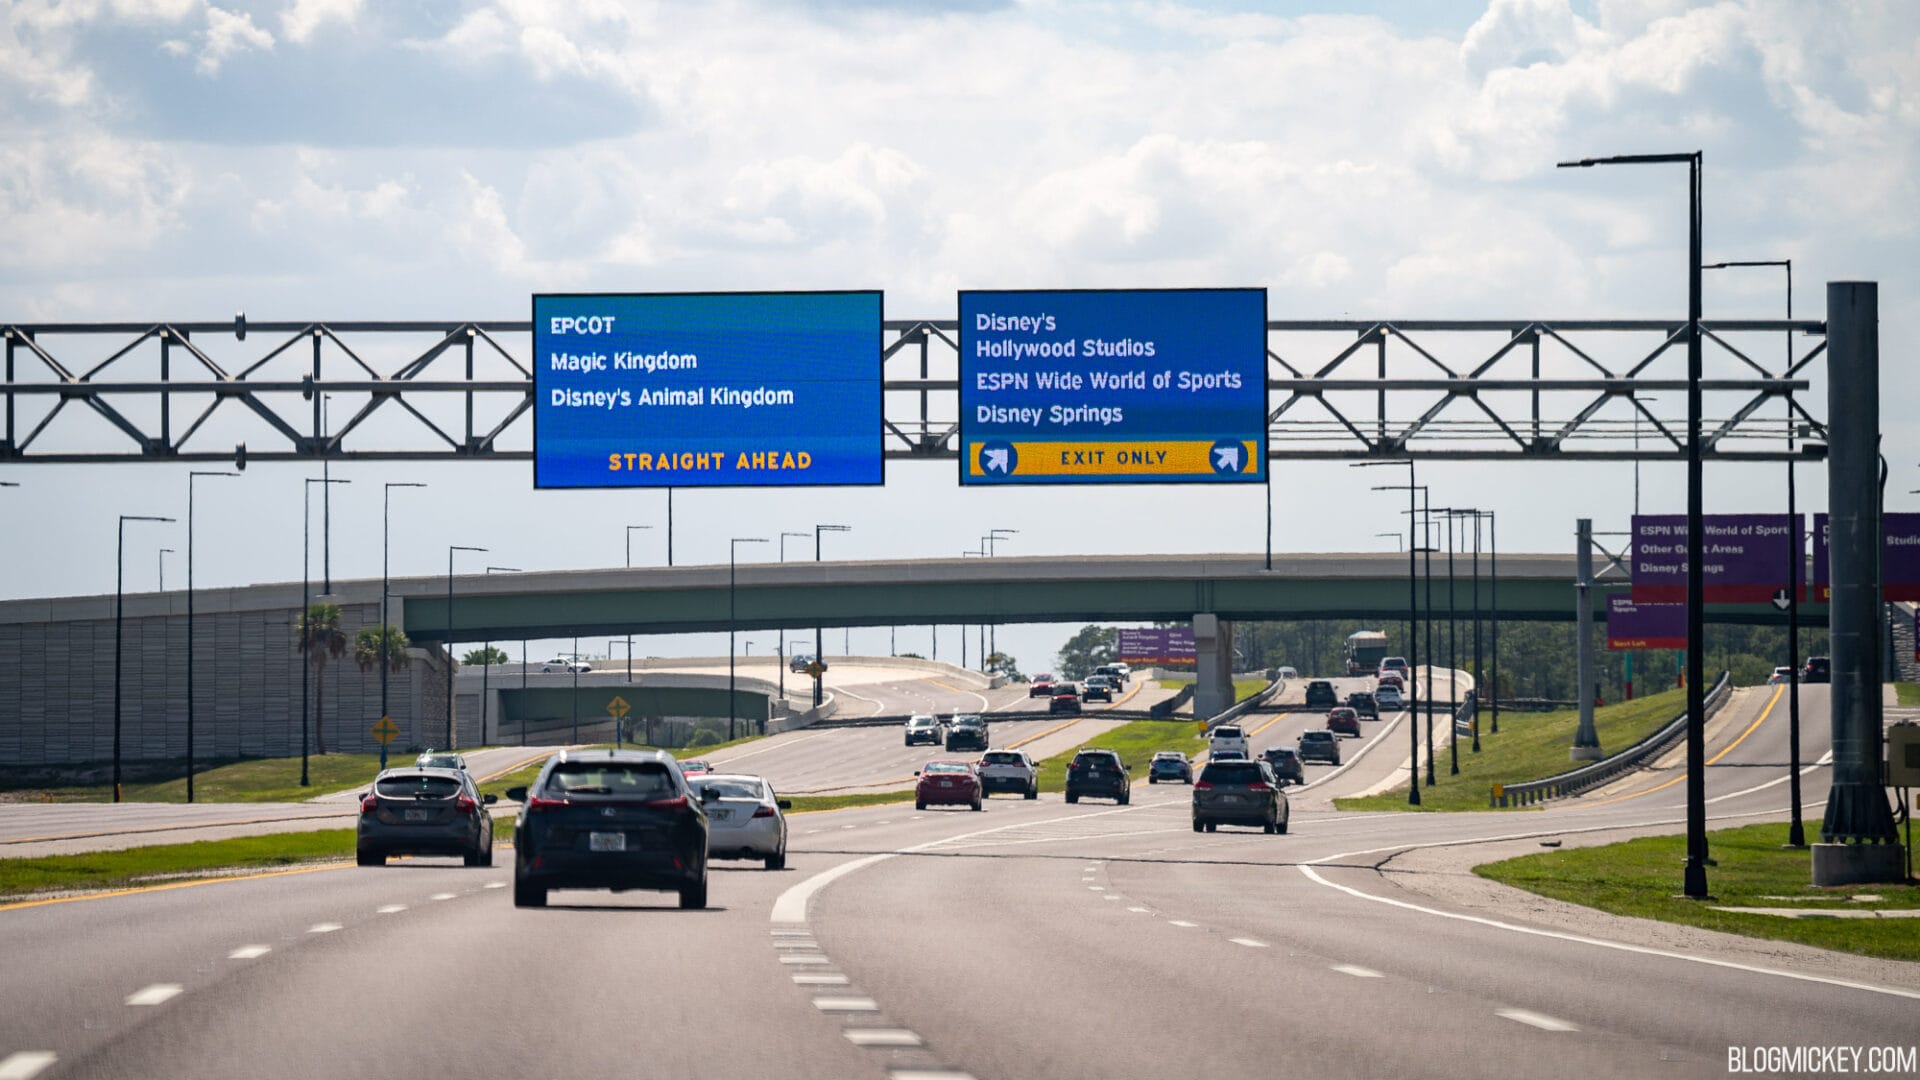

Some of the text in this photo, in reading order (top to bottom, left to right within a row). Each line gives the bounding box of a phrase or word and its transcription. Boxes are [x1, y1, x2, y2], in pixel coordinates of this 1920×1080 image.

[551, 316, 615, 335] EPCOT
[976, 313, 1056, 334] Disney's
[976, 338, 1156, 361] Hollywood Studios
[551, 351, 698, 374] Magic Kingdom
[976, 370, 1242, 392] ESPN Wide World of Sports
[551, 386, 794, 410] Disney's Animal Kingdom
[976, 404, 1123, 427] Disney Springs
[608, 451, 813, 471] STRAIGHT AHEAD
[1061, 451, 1168, 466] EXIT ONLY
[1640, 525, 1671, 536] ESPN
[1705, 525, 1738, 536] World
[1741, 525, 1752, 535] of
[1755, 525, 1789, 537] Sport
[1640, 544, 1672, 554] Other
[1711, 544, 1744, 554] Areas
[1640, 562, 1724, 575] Disney Sngs
